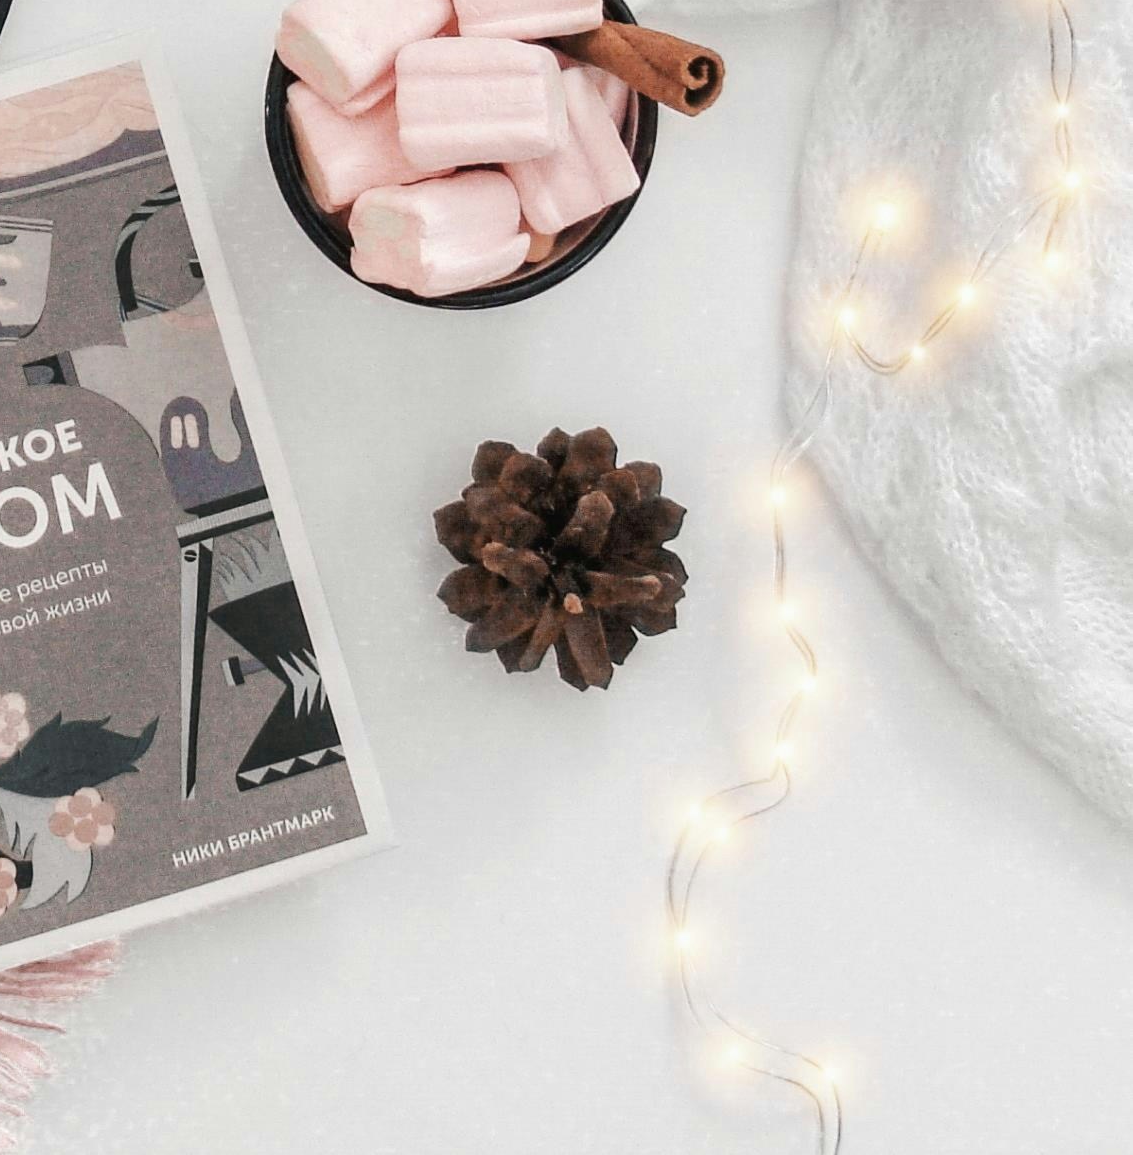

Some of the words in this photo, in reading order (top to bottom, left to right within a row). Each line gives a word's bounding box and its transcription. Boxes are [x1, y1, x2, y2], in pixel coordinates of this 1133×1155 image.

[16, 559, 108, 602] рецепты
[44, 589, 111, 622] жизни
[172, 840, 225, 869] НИКИ
[227, 806, 336, 851] БРАНТМАРК
